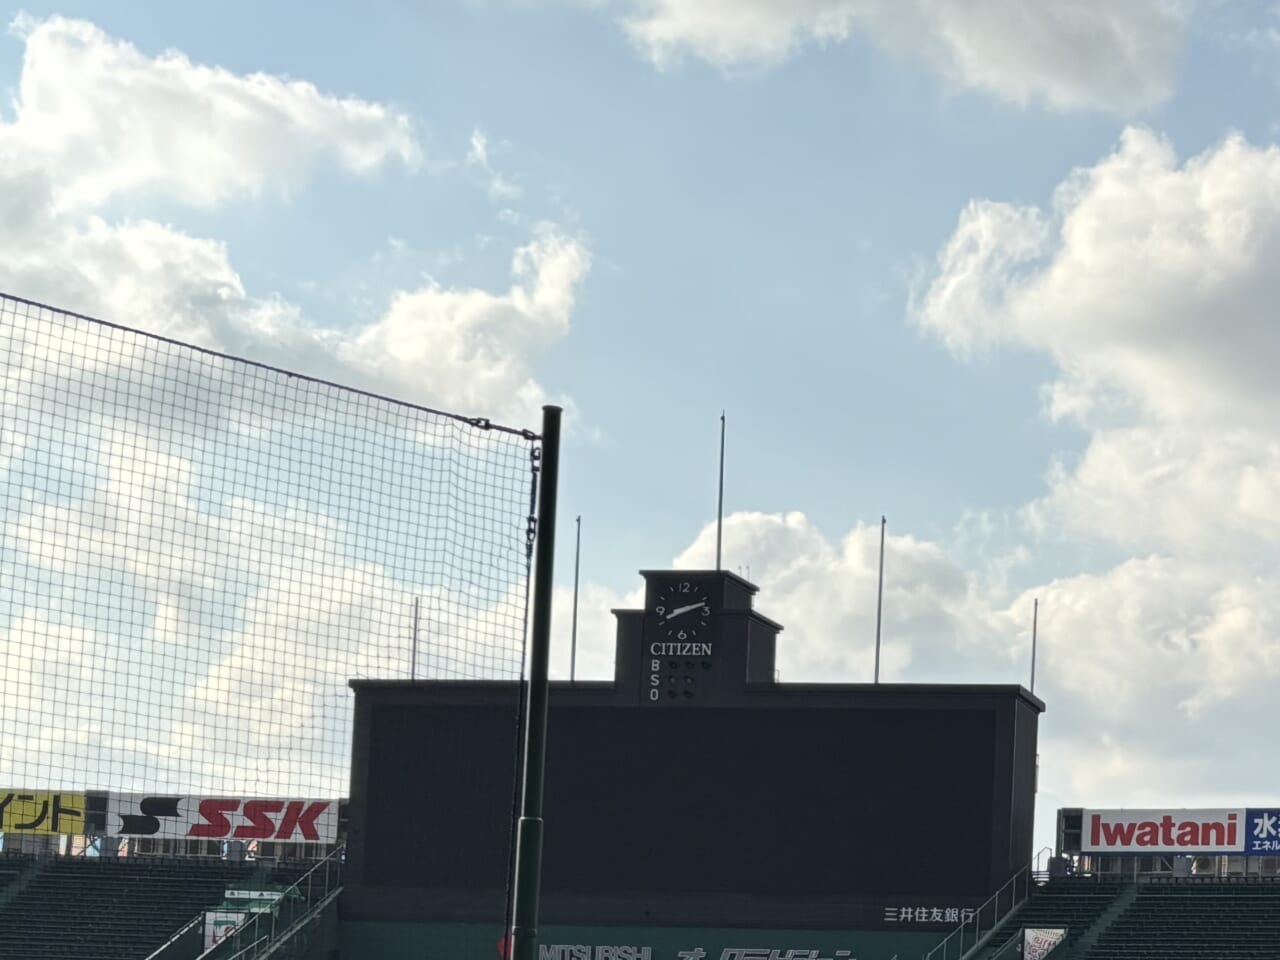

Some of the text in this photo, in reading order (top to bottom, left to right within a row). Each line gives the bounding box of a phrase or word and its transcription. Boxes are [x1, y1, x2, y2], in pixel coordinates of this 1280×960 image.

[650, 642, 713, 656] CITIZEN
[651, 659, 660, 672] B
[650, 674, 660, 686] S
[186, 799, 330, 841] SSK
[1090, 813, 1237, 847] Iwatani
[884, 907, 976, 923] 三井住友銀行
